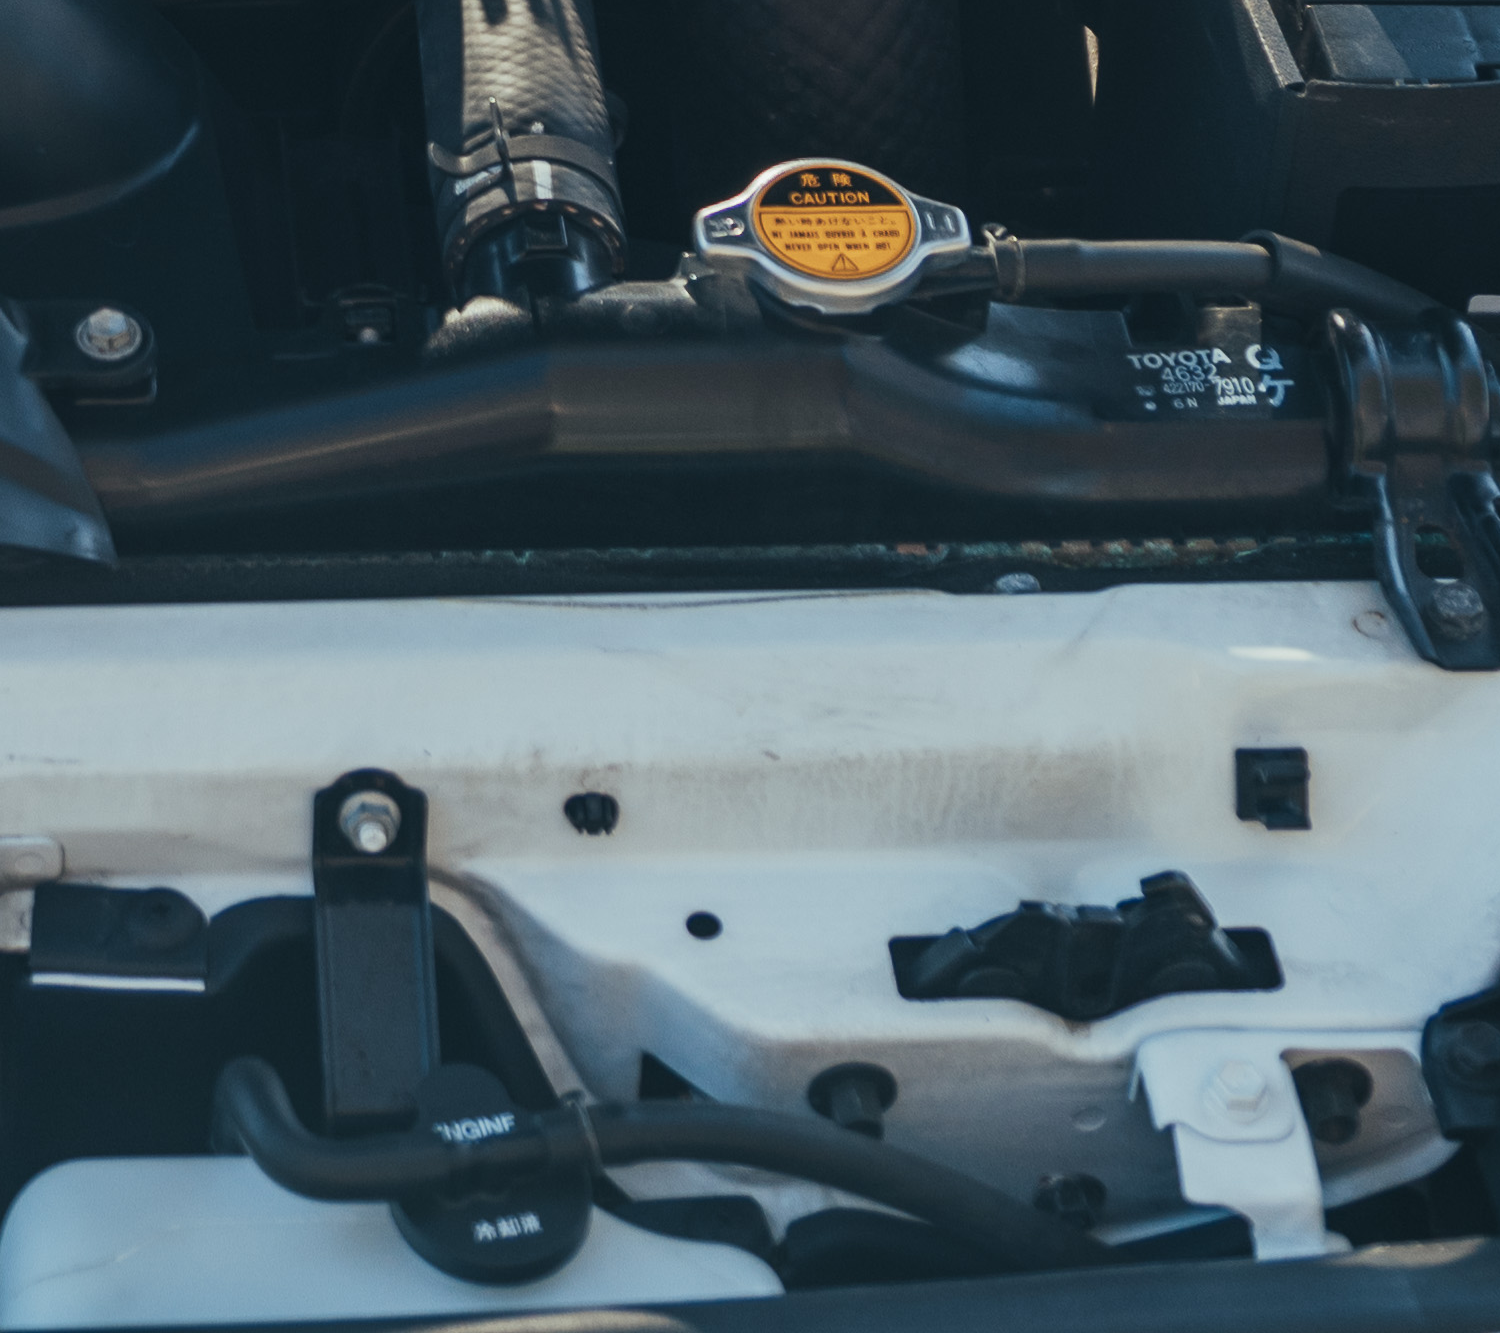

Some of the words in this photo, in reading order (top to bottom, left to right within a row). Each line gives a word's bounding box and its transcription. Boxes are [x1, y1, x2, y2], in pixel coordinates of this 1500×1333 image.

[800, 173, 853, 188] 危険
[790, 191, 870, 205] CAUTION
[1127, 347, 1232, 370] TOYOTA
[1162, 364, 1220, 384] 4632
[1217, 395, 1257, 406] JAPAN
